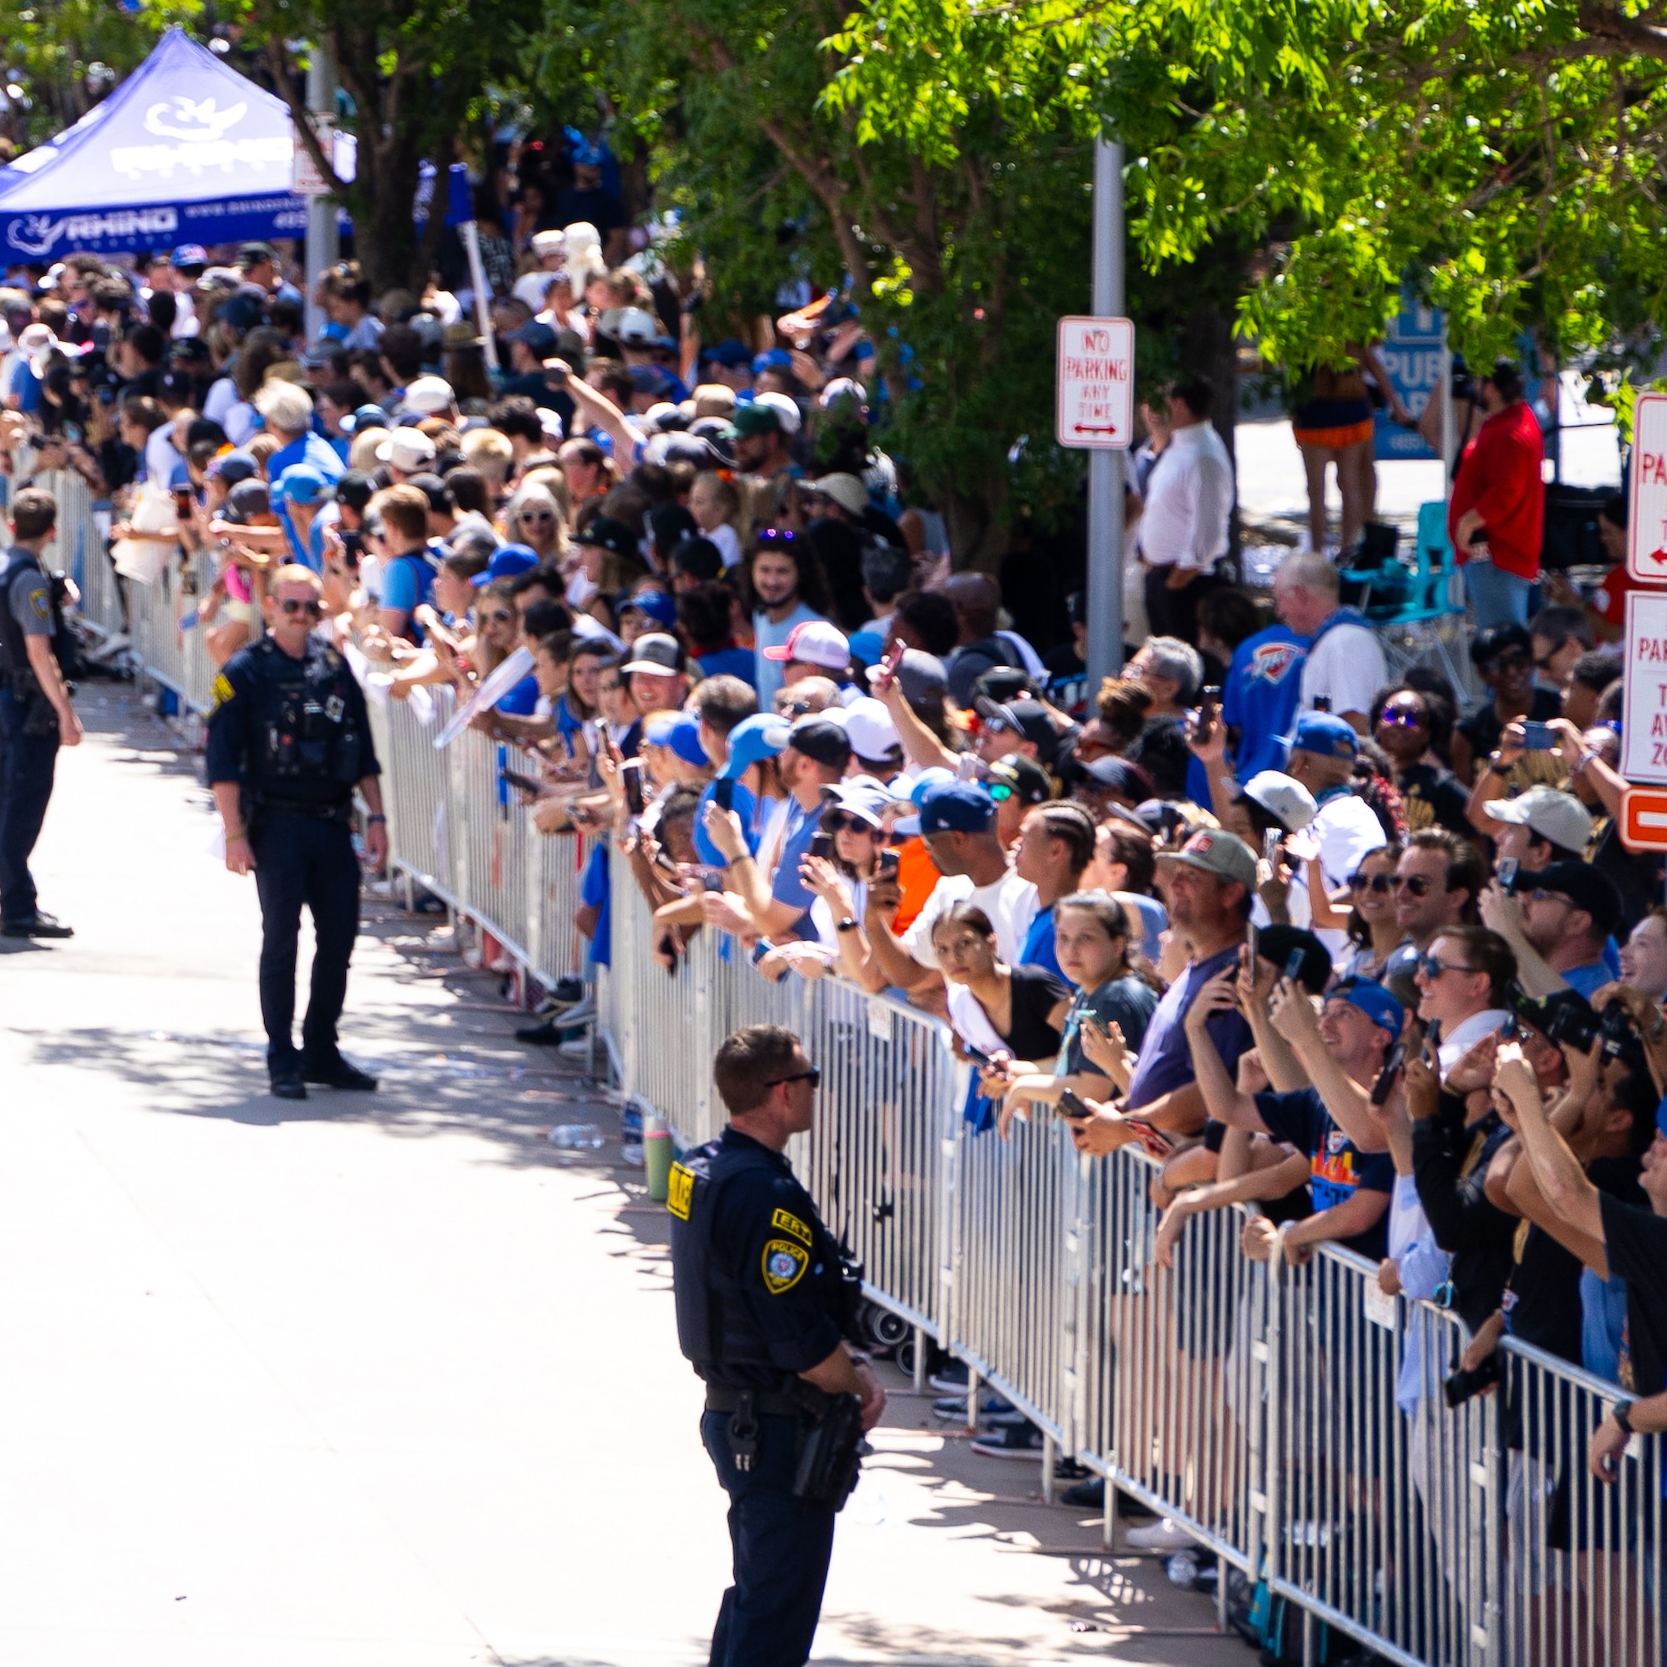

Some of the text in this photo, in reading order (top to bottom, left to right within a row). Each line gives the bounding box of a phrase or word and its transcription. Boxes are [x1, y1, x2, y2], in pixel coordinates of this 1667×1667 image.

[1082, 330, 1110, 353] NO
[1064, 358, 1127, 381] PARKING
[1082, 385, 1110, 399] ANY
[1078, 402, 1113, 420] TIME
[771, 1241, 804, 1261] POLICE
